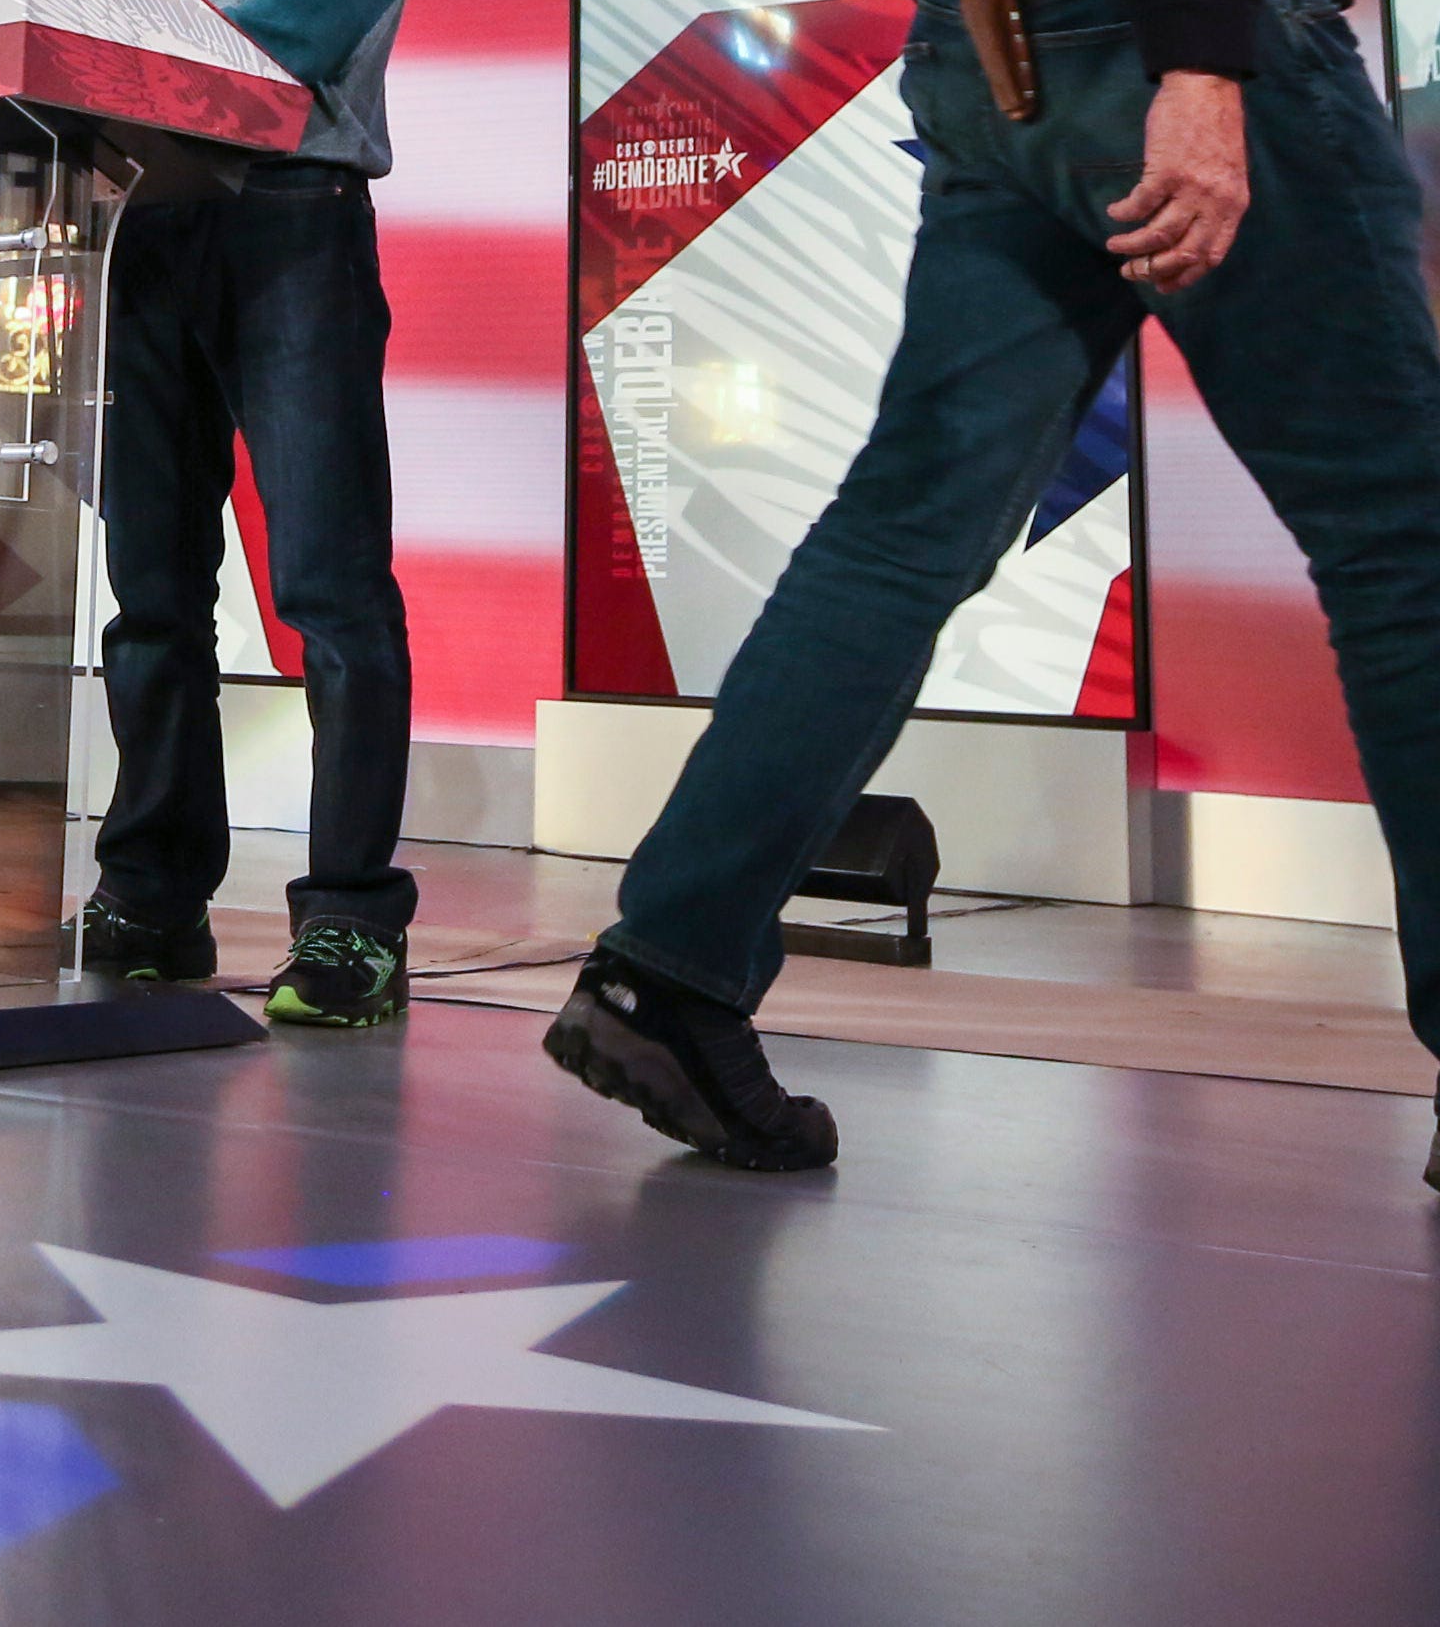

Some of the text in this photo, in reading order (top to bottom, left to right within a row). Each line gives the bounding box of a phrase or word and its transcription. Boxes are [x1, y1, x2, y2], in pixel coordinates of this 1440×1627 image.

[616, 141, 640, 158] CBS
[659, 137, 695, 155] NEWS
[635, 411, 668, 579] PRESIDENTIAL
